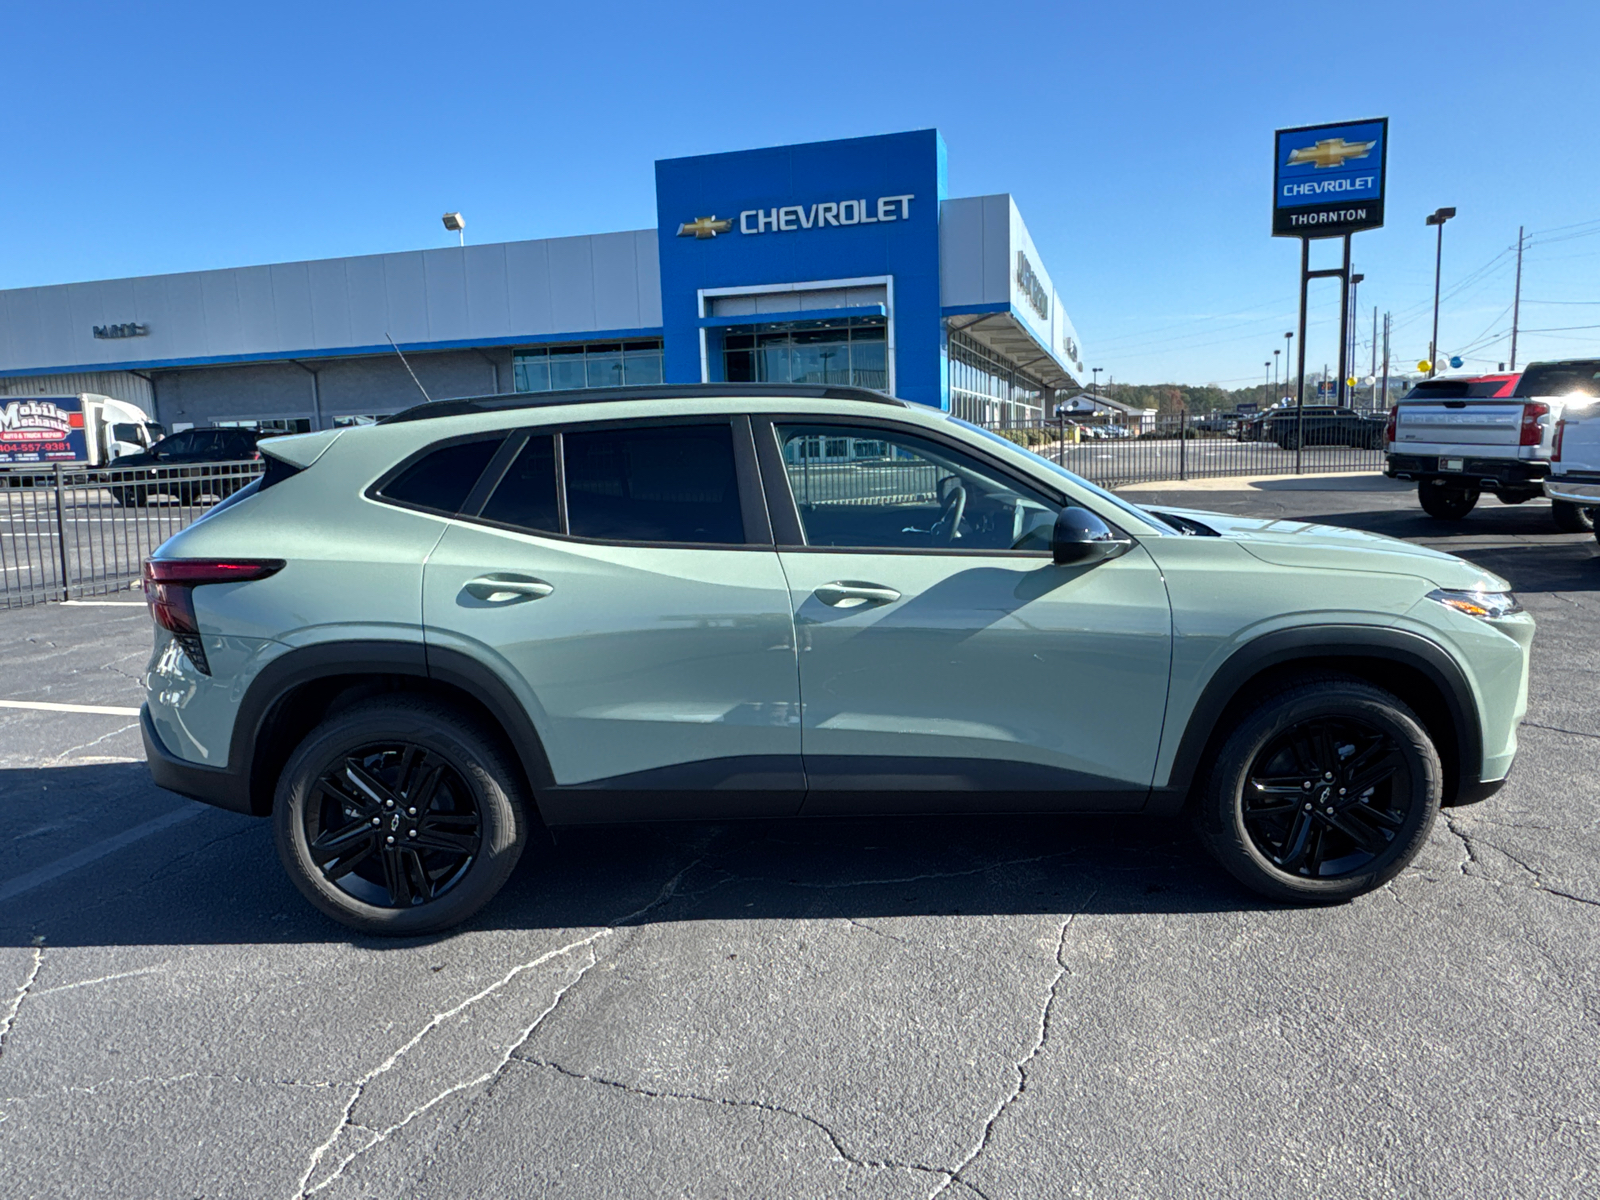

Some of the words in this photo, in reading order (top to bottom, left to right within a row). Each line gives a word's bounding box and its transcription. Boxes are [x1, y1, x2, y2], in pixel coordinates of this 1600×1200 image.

[1283, 176, 1375, 197] CHEVROLET
[739, 194, 915, 235] CHEVROLET
[1290, 208, 1367, 226] THORNTON
